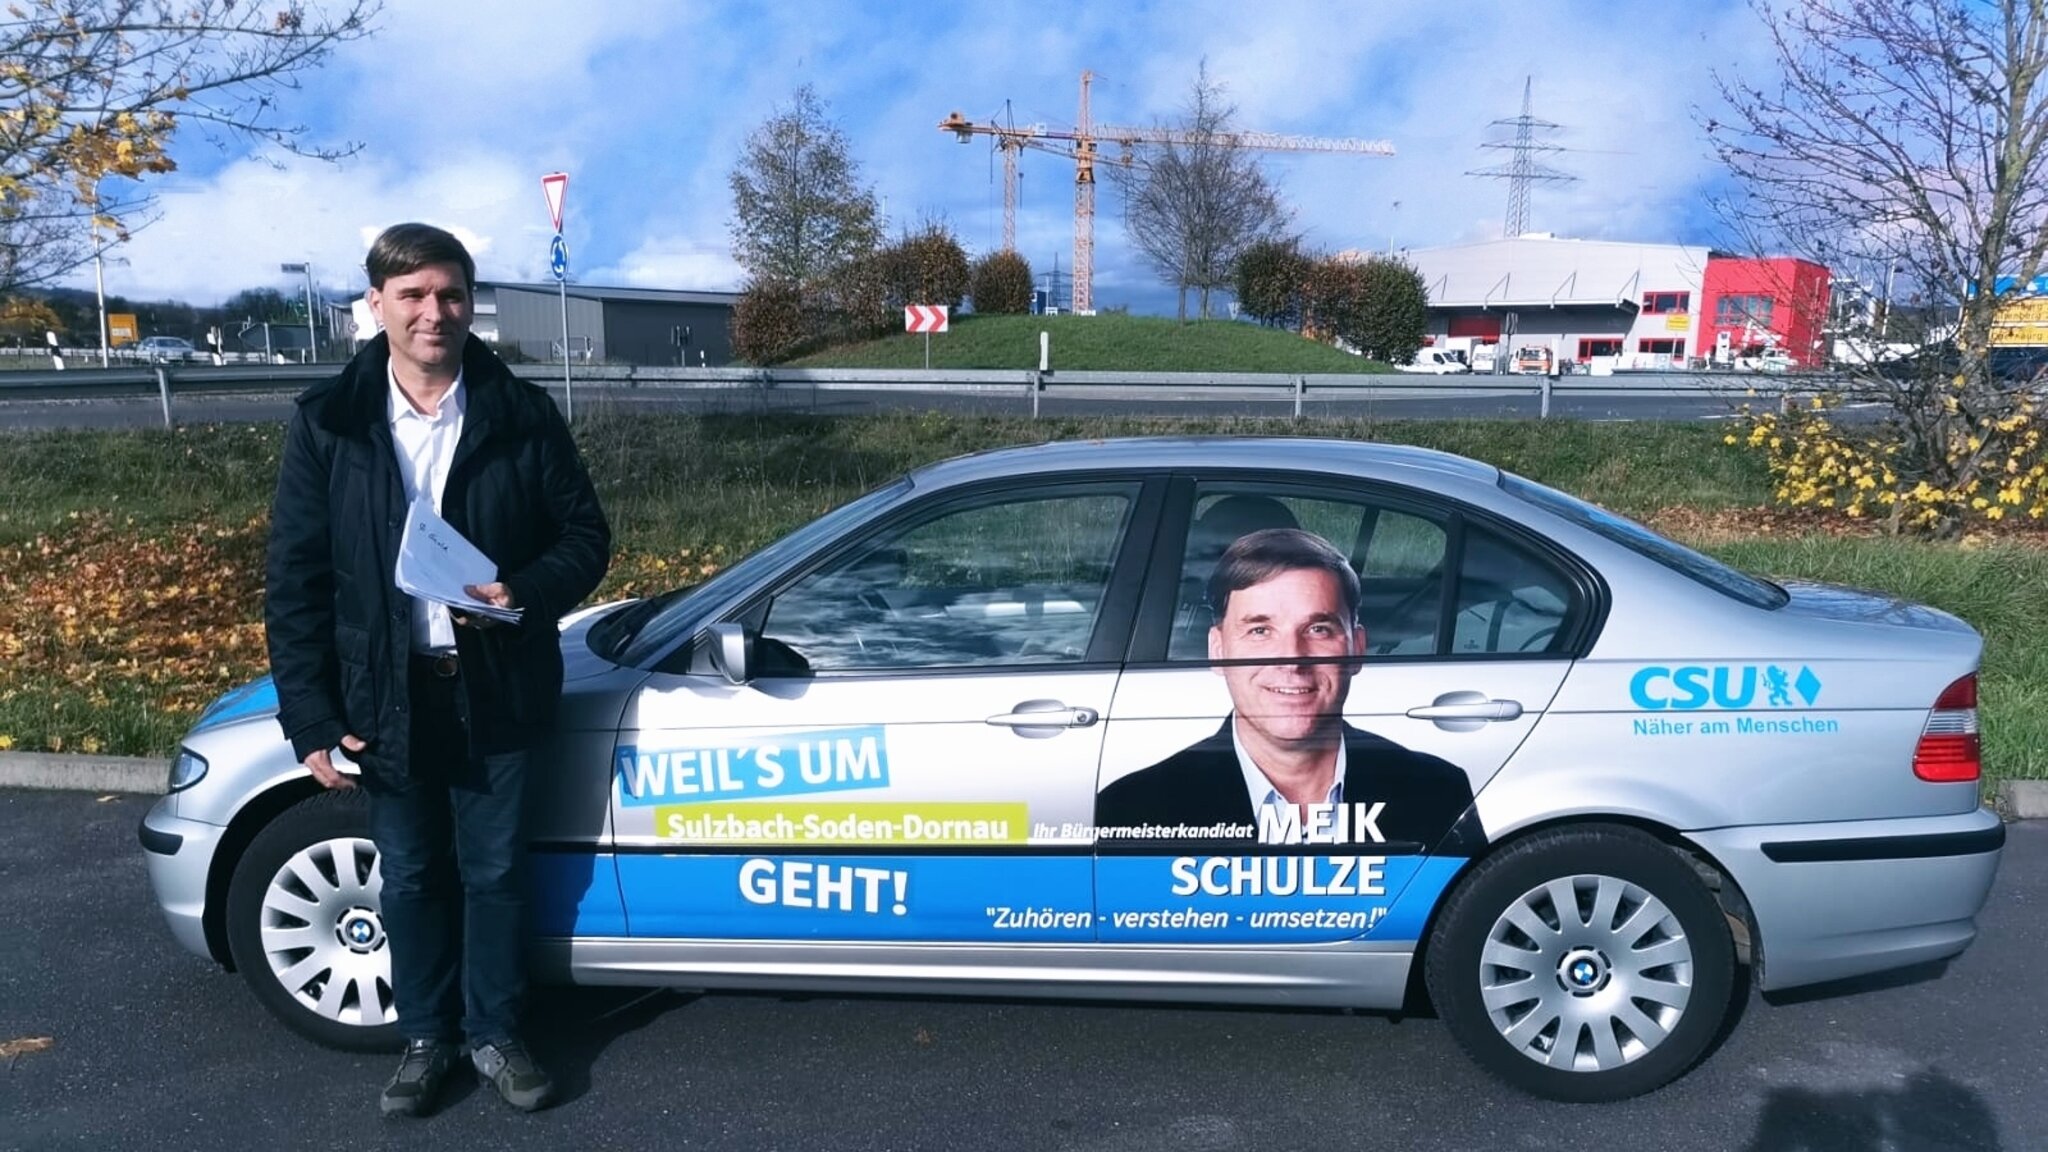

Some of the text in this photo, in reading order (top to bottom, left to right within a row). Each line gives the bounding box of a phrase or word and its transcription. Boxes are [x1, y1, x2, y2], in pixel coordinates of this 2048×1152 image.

[1630, 666, 1757, 709] CSU
[1633, 717, 1839, 735] Näher am Menschen
[799, 736, 882, 785] UM
[667, 813, 1008, 840] Sulzbach-Soden-Dornau
[1033, 822, 1254, 843] Ihr Bürgermeisterkandidat
[1258, 802, 1387, 845] MEIK
[738, 858, 908, 916] GEHT!
[1171, 856, 1387, 897] SCHULZE
[986, 907, 1092, 928] "Zuhören
[1112, 907, 1228, 928] verstehen
[1250, 907, 1387, 929] umsetzen!"
